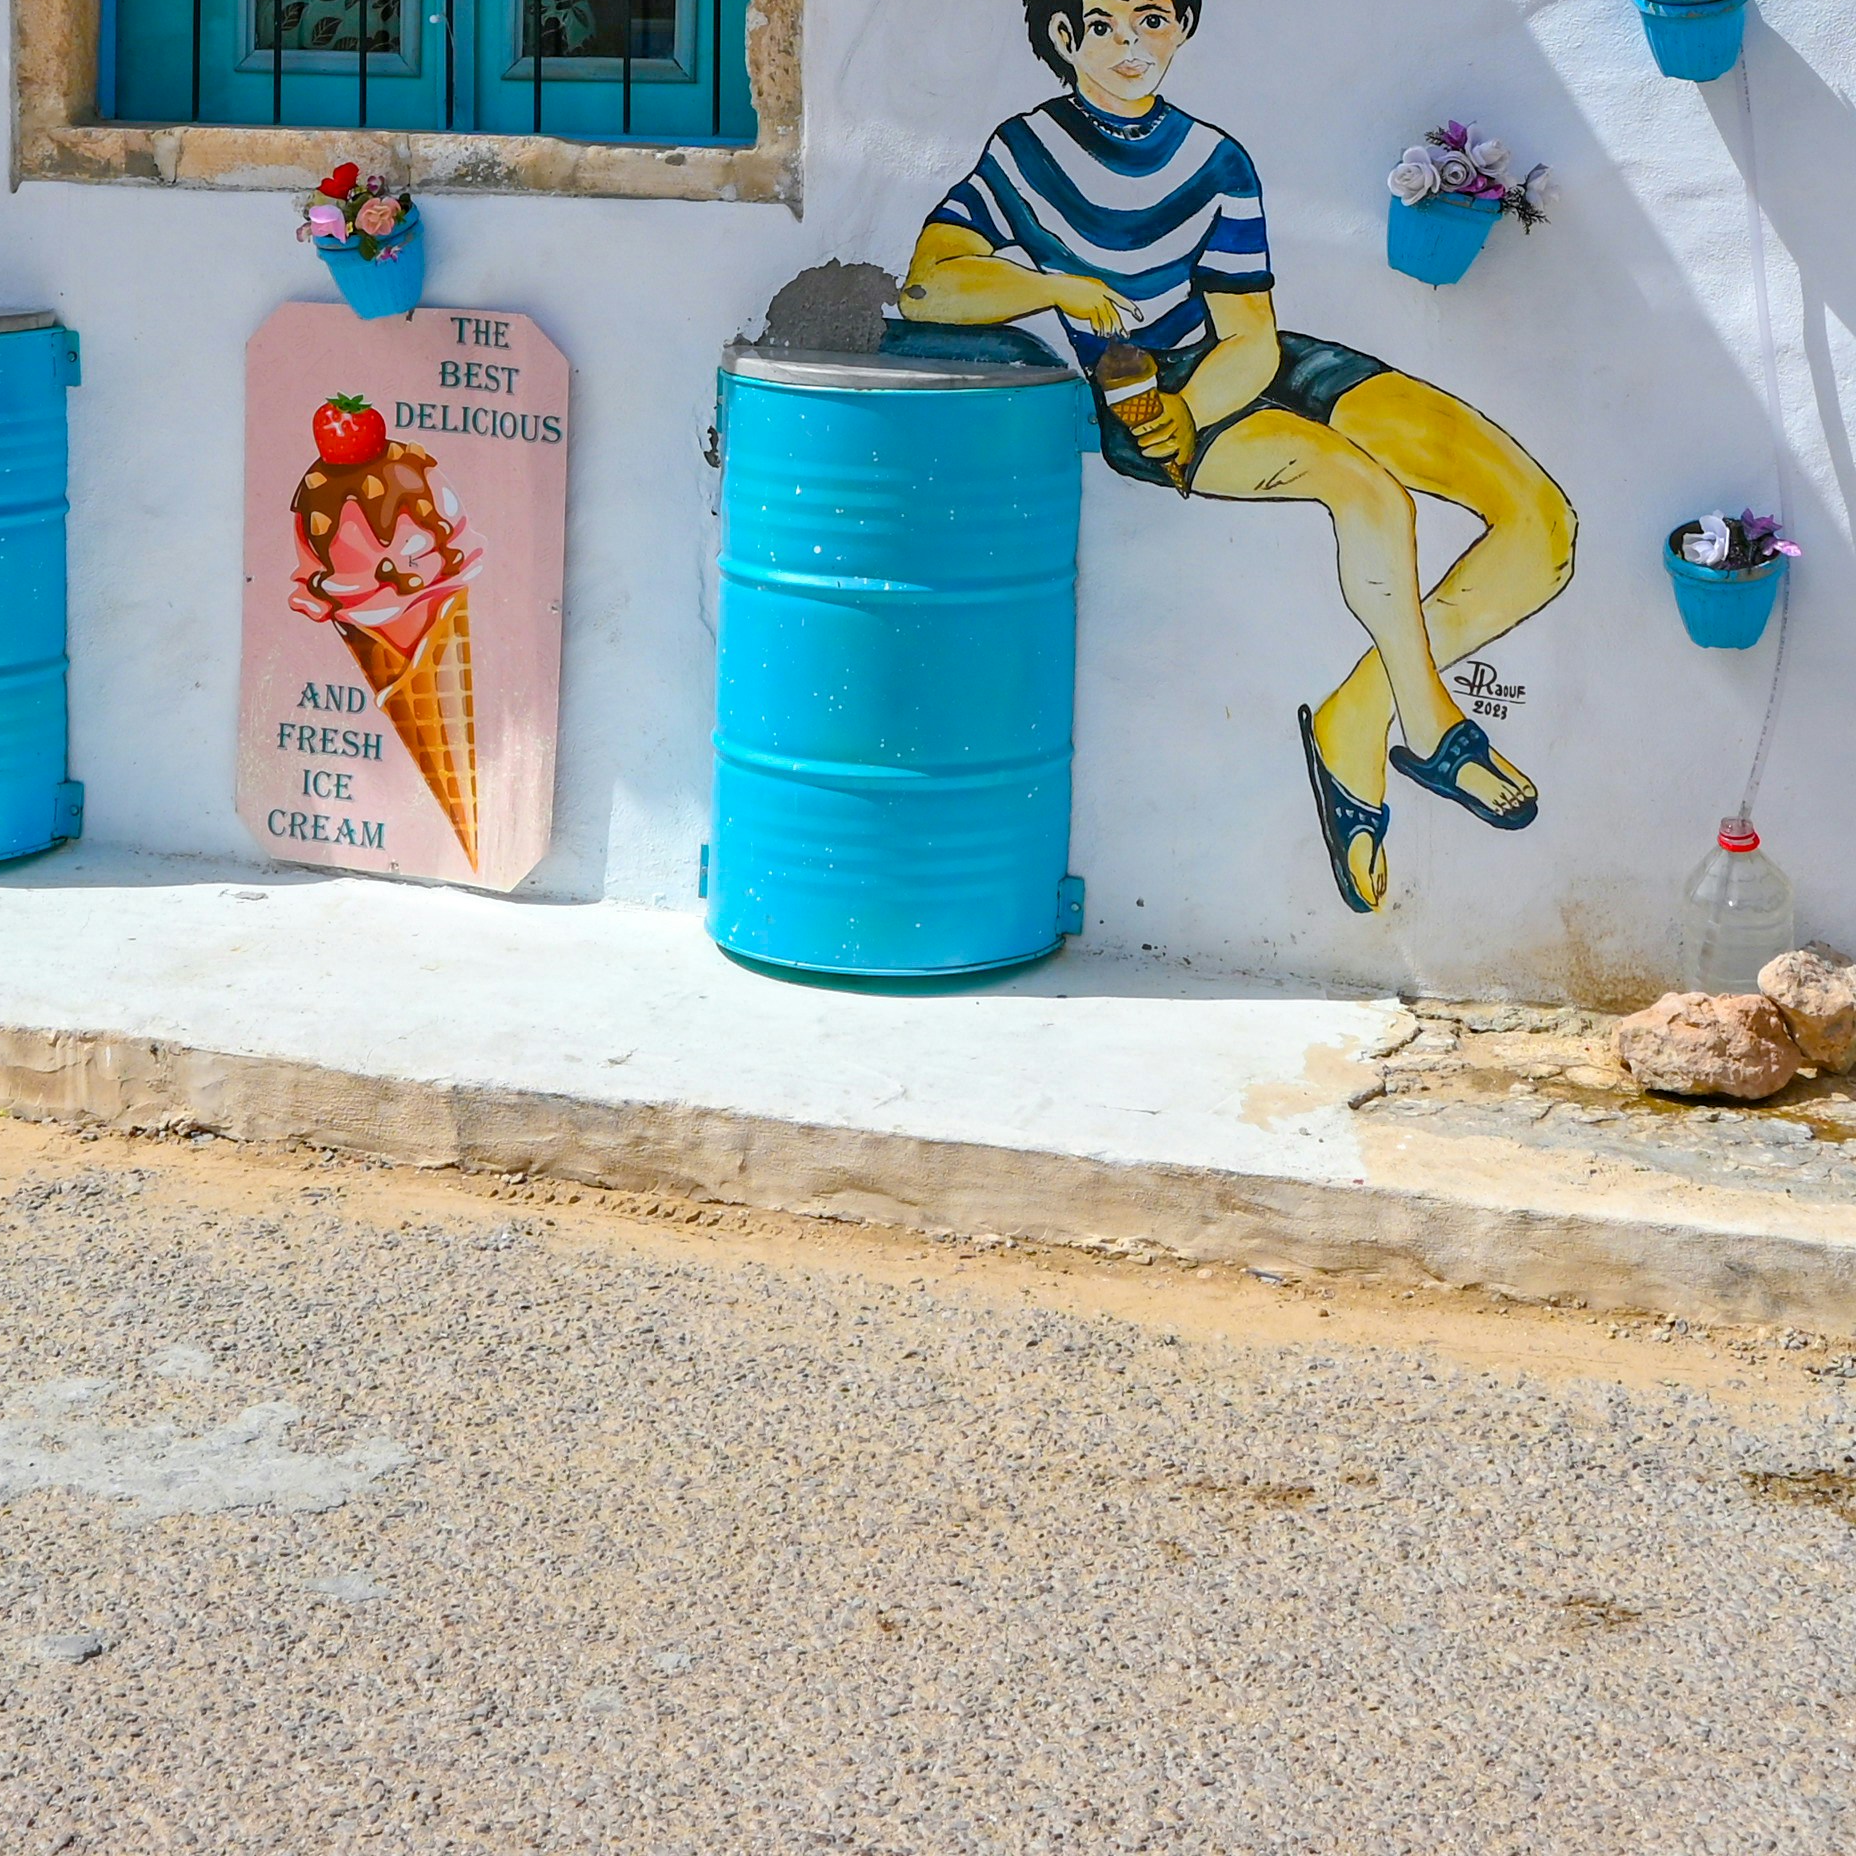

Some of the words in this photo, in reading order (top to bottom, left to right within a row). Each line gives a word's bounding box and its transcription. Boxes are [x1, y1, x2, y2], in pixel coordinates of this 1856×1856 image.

[450, 315, 512, 350] THE
[439, 359, 520, 396] BEST
[394, 400, 563, 445] DELICIOUS
[296, 680, 367, 714] AND
[1472, 700, 1509, 721] 2023
[276, 721, 384, 762] FRESH
[301, 768, 354, 802] ICE
[267, 809, 386, 851] CREAM
